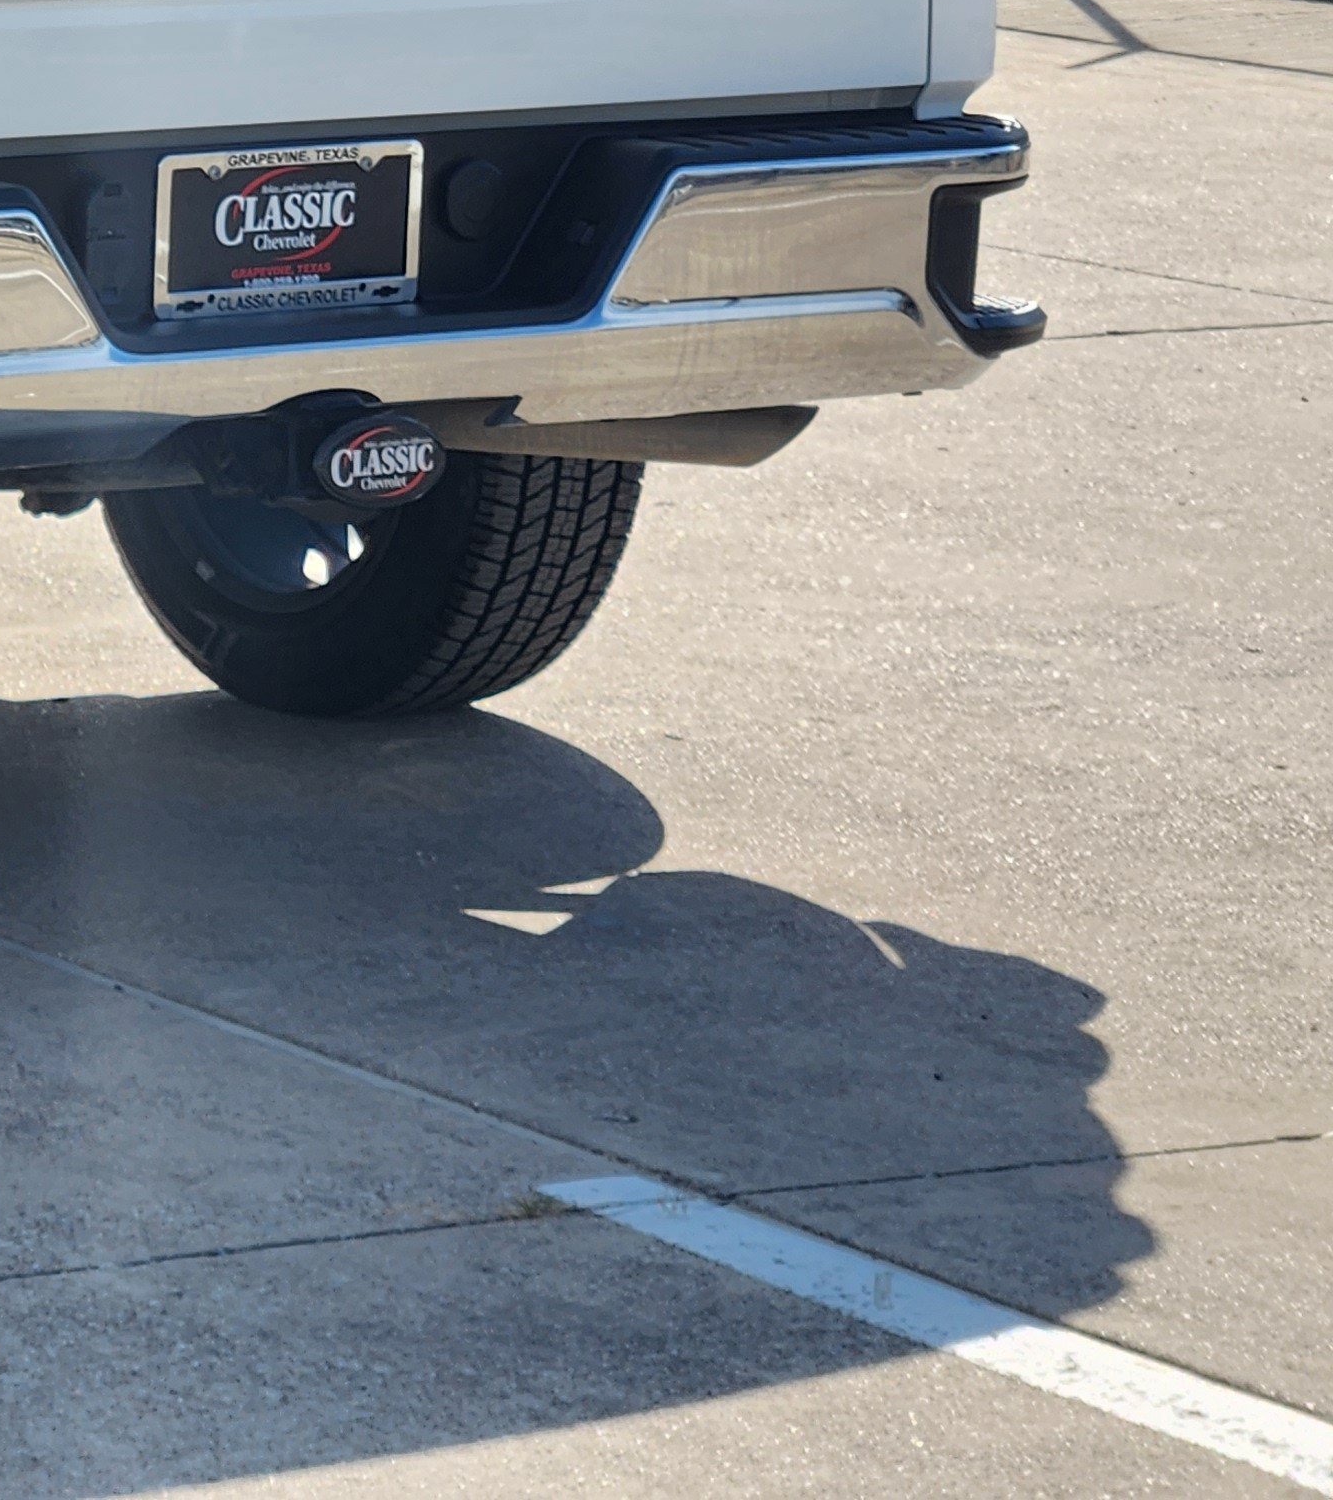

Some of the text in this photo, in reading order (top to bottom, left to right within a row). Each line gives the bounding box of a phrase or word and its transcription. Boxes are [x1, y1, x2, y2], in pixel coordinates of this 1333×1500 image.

[316, 147, 359, 160] TEXAS
[214, 190, 356, 247] CLASSIC
[253, 230, 317, 251] Chevrolet
[216, 288, 358, 312] CLASSIC CHEVROLET
[330, 443, 434, 488] CLASSIC
